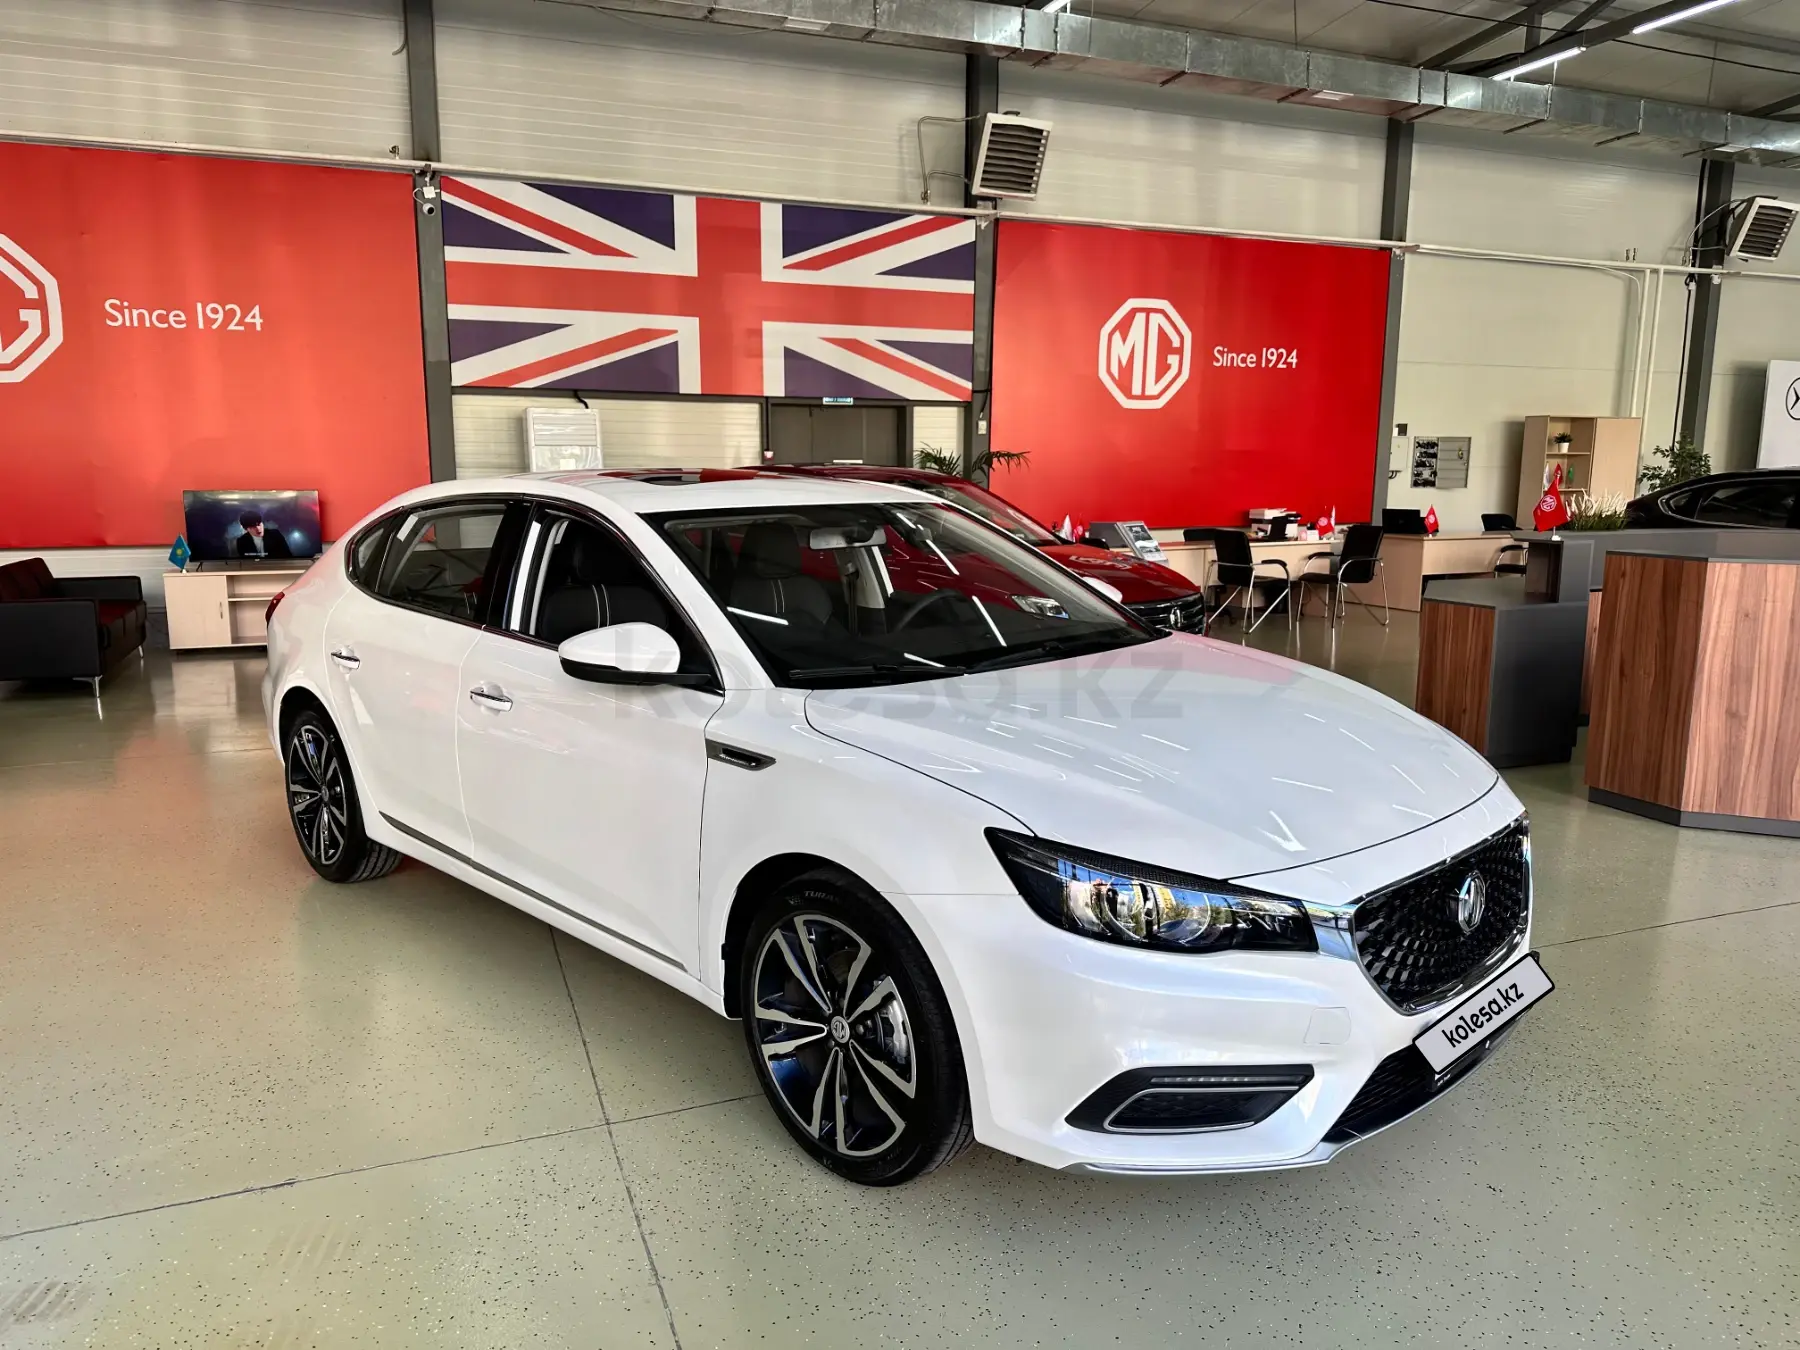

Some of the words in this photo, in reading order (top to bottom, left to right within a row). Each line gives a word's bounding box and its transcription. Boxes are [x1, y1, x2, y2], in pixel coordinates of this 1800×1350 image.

[104, 298, 187, 329] Since
[196, 301, 264, 331] 1924
[1109, 311, 1182, 397] MG
[1212, 345, 1257, 368] Since
[1261, 347, 1298, 369] 1924
